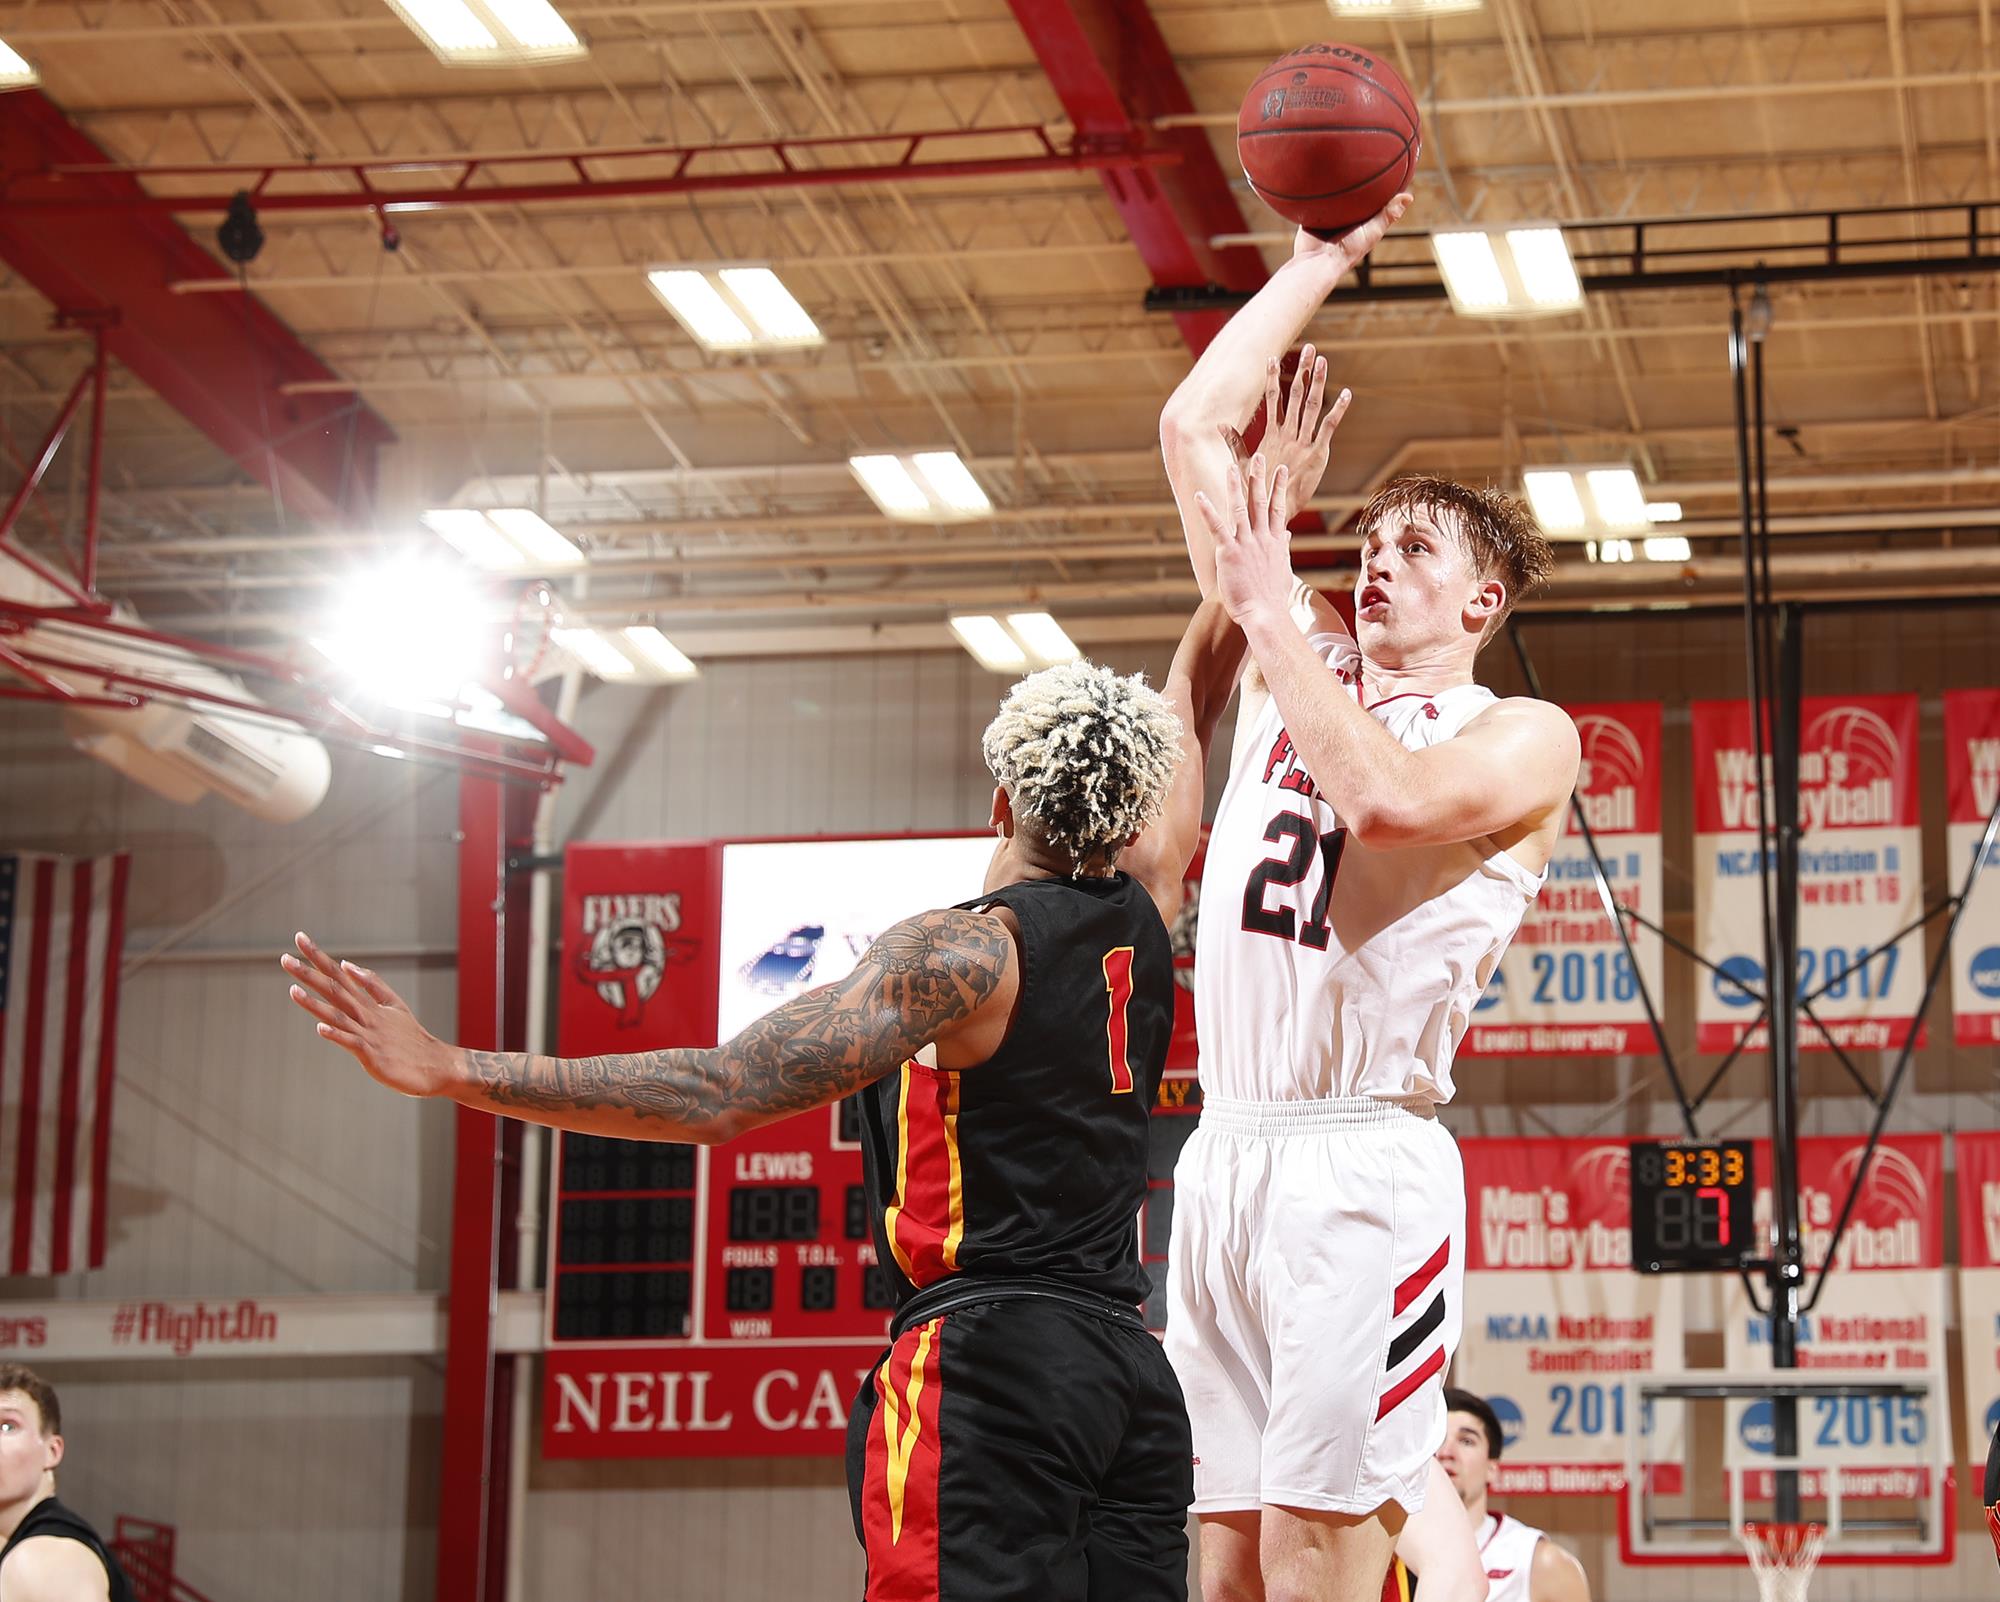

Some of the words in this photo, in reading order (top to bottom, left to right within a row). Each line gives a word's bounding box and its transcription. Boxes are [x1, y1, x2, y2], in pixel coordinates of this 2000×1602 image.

[1241, 809, 1348, 951] 21
[1799, 878, 1865, 905] weet
[583, 892, 682, 934] FLYERS
[1533, 951, 1640, 1004] 2018
[1796, 944, 1899, 1001] 2017
[1102, 946, 1135, 1094] 1
[1530, 1024, 1627, 1052] University
[736, 1151, 813, 1181] LEWIS
[1664, 1150, 1744, 1187] 3:33
[1480, 1185, 1569, 1225] Men's
[722, 1246, 779, 1267] FOULS
[1481, 1219, 1632, 1271] Volleyba
[729, 1319, 773, 1338] WON
[1486, 1315, 1549, 1340] NCAA
[1556, 1313, 1654, 1341] National
[1820, 1315, 1927, 1342] National
[1528, 1346, 1654, 1373] Semifinalist
[553, 1371, 733, 1433] NEIL
[752, 1368, 872, 1432] CA
[1815, 1394, 1927, 1447] 2015
